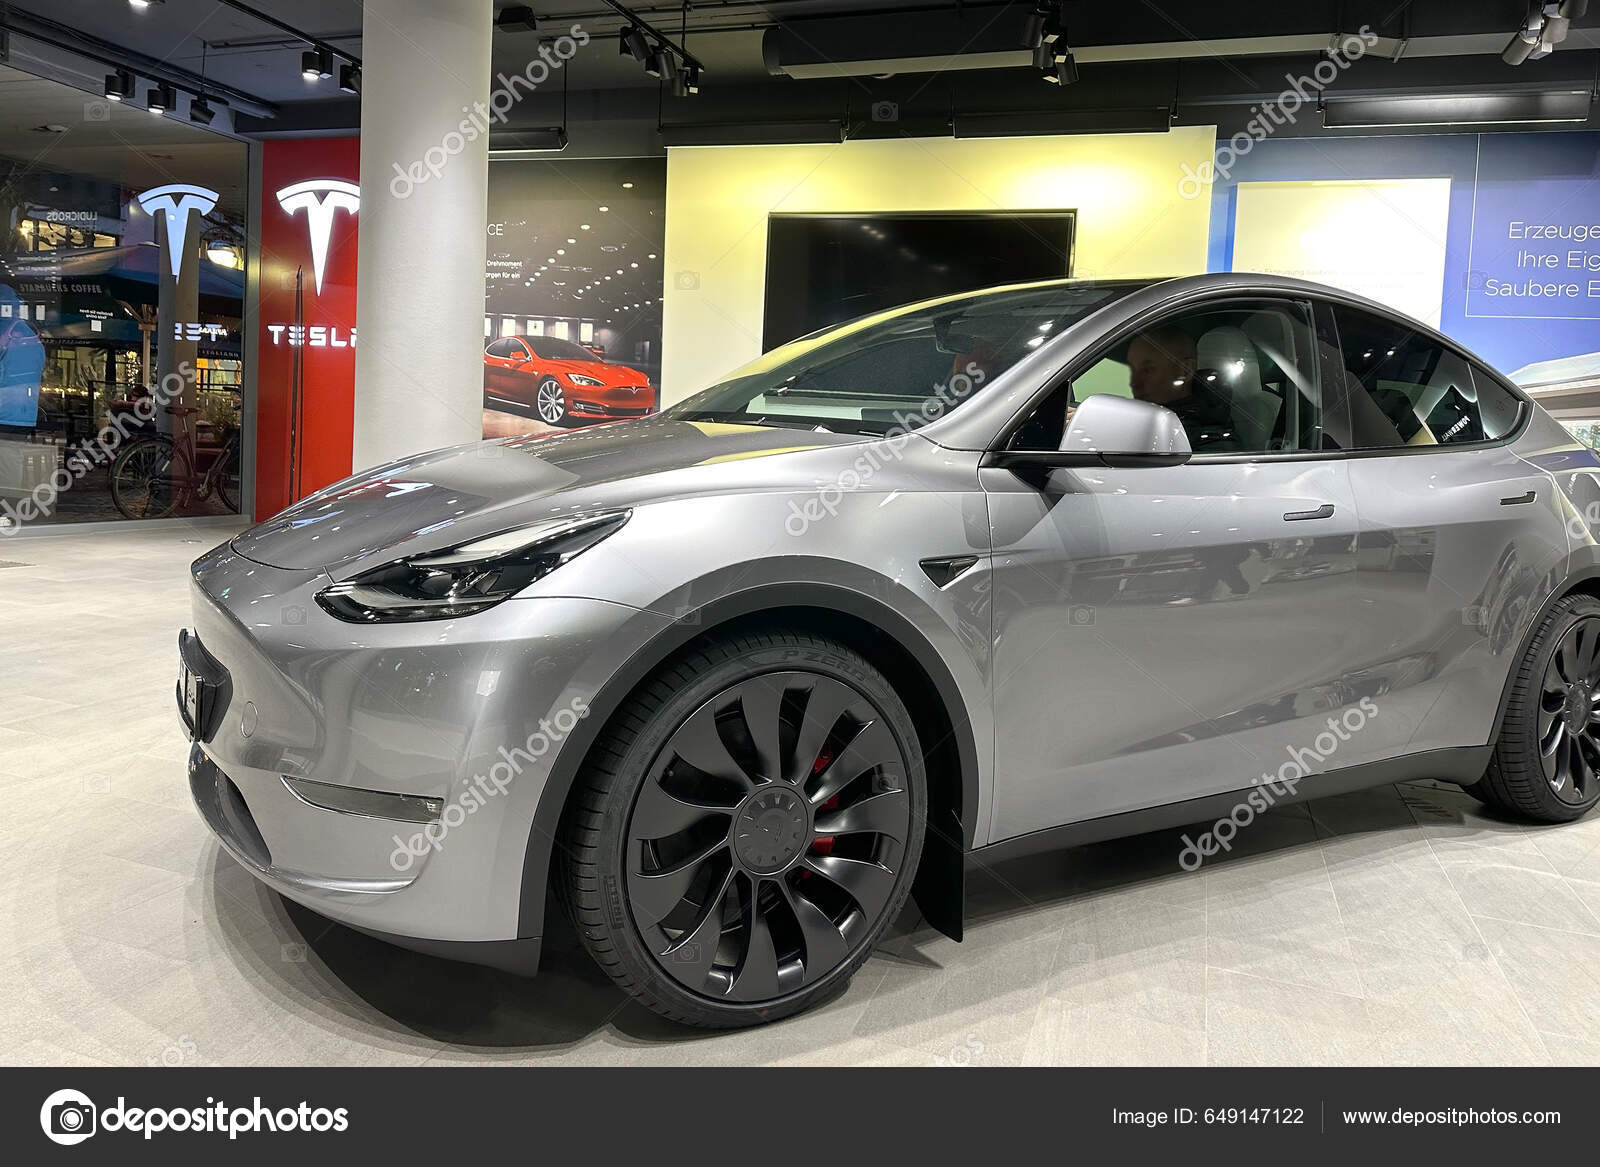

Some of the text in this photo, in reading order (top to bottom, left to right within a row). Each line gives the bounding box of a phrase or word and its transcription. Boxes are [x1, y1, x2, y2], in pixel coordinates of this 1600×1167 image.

[1508, 221, 1600, 242] Erzeuge
[1517, 250, 1559, 268] Ihre
[1484, 279, 1580, 298] Saubere
